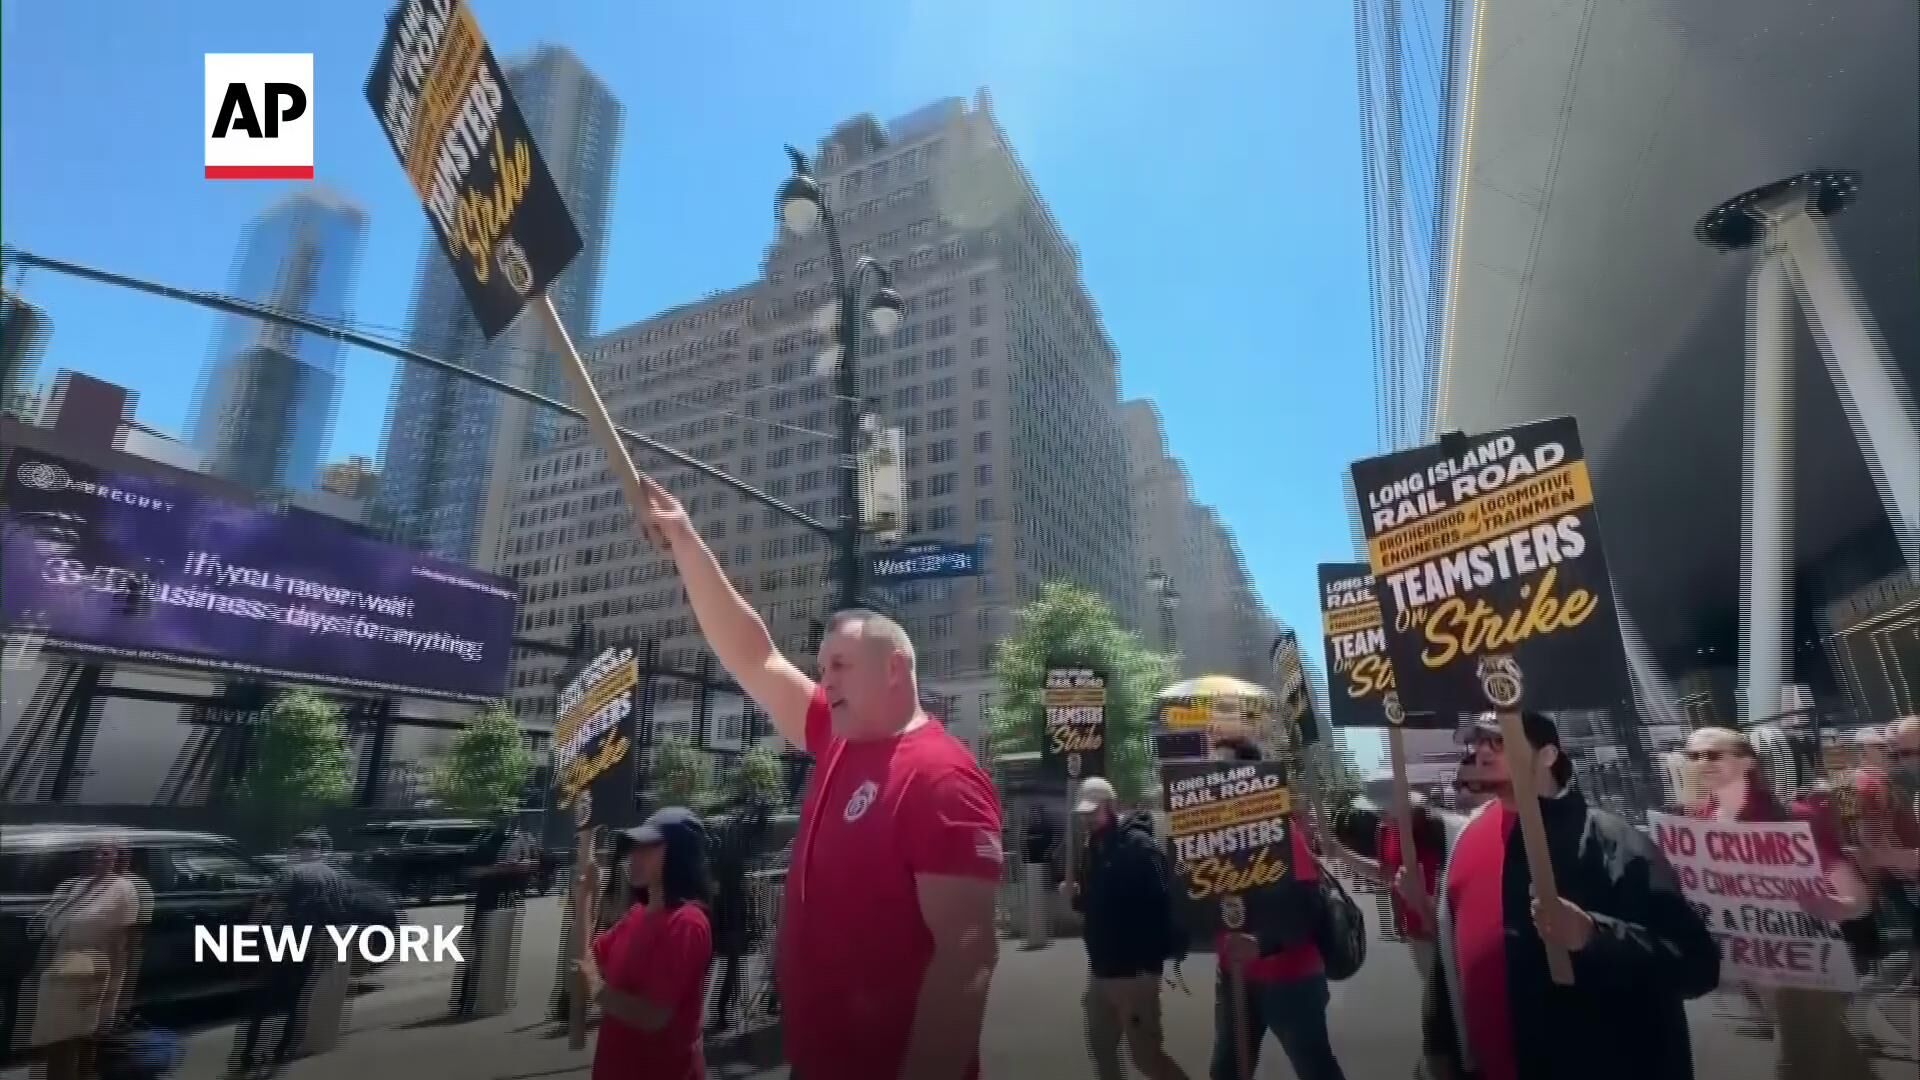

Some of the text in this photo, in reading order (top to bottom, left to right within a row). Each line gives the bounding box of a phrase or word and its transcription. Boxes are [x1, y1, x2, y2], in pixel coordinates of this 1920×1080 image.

[426, 60, 504, 238] TEAMSTERS
[457, 121, 532, 285] Strike
[64, 478, 175, 512] MERCURY
[1368, 436, 1516, 511] LONG ISLAND
[1371, 442, 1565, 532] RAIL ROAD
[1379, 512, 1465, 552] BROTHERHOOD
[1479, 472, 1573, 516] LOCOMOTIVE
[1382, 531, 1461, 568] ENGINEERS
[1483, 489, 1576, 531] TRAINMEN
[1326, 577, 1364, 594] LONG
[1387, 515, 1586, 613] TEAMSTERS
[1327, 588, 1377, 609] RAIL
[1421, 566, 1599, 668] Strike
[1331, 627, 1386, 662] TEAM
[1169, 789, 1216, 809] RAIL
[1220, 775, 1279, 799] ROAD
[1173, 818, 1285, 861] TEAMSTERS
[1656, 823, 1815, 867] NO CRUMBS
[1187, 846, 1288, 900] Strike
[1722, 908, 1739, 931] A
